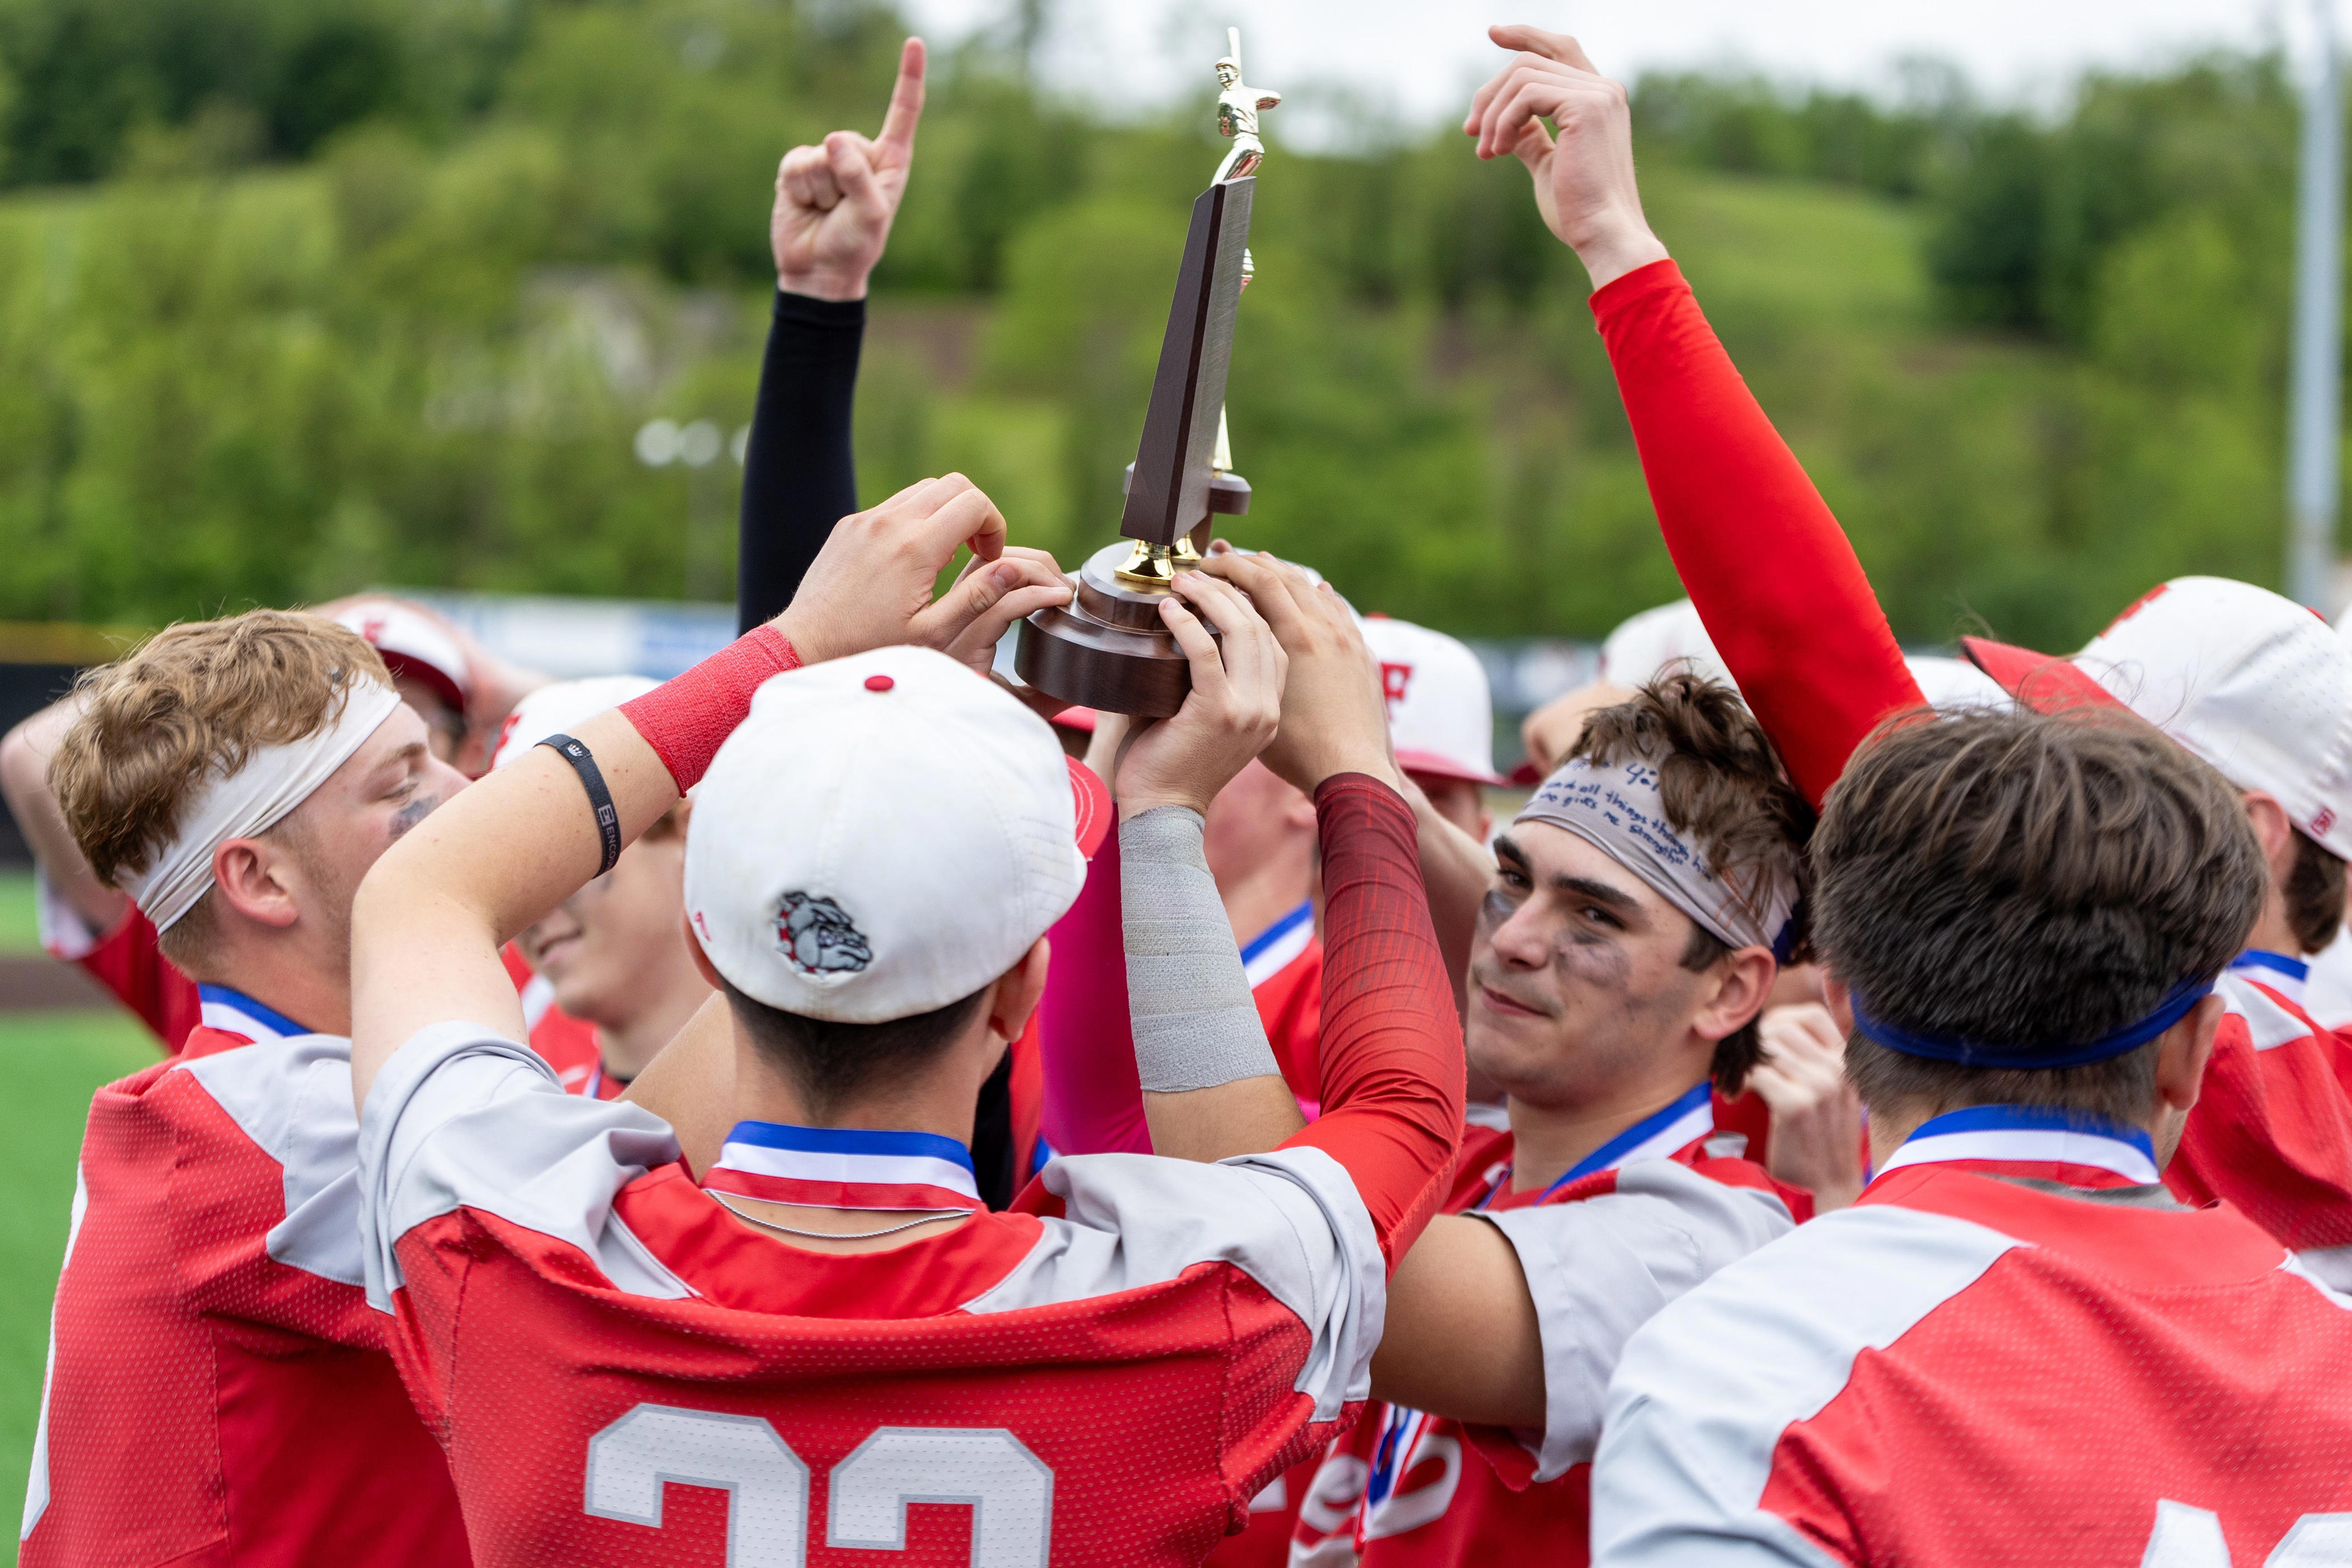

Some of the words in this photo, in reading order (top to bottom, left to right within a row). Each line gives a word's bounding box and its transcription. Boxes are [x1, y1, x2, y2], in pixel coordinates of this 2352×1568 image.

[1579, 784, 1602, 795] all
[1606, 790, 1648, 825] things
[1652, 819, 1690, 861] through
